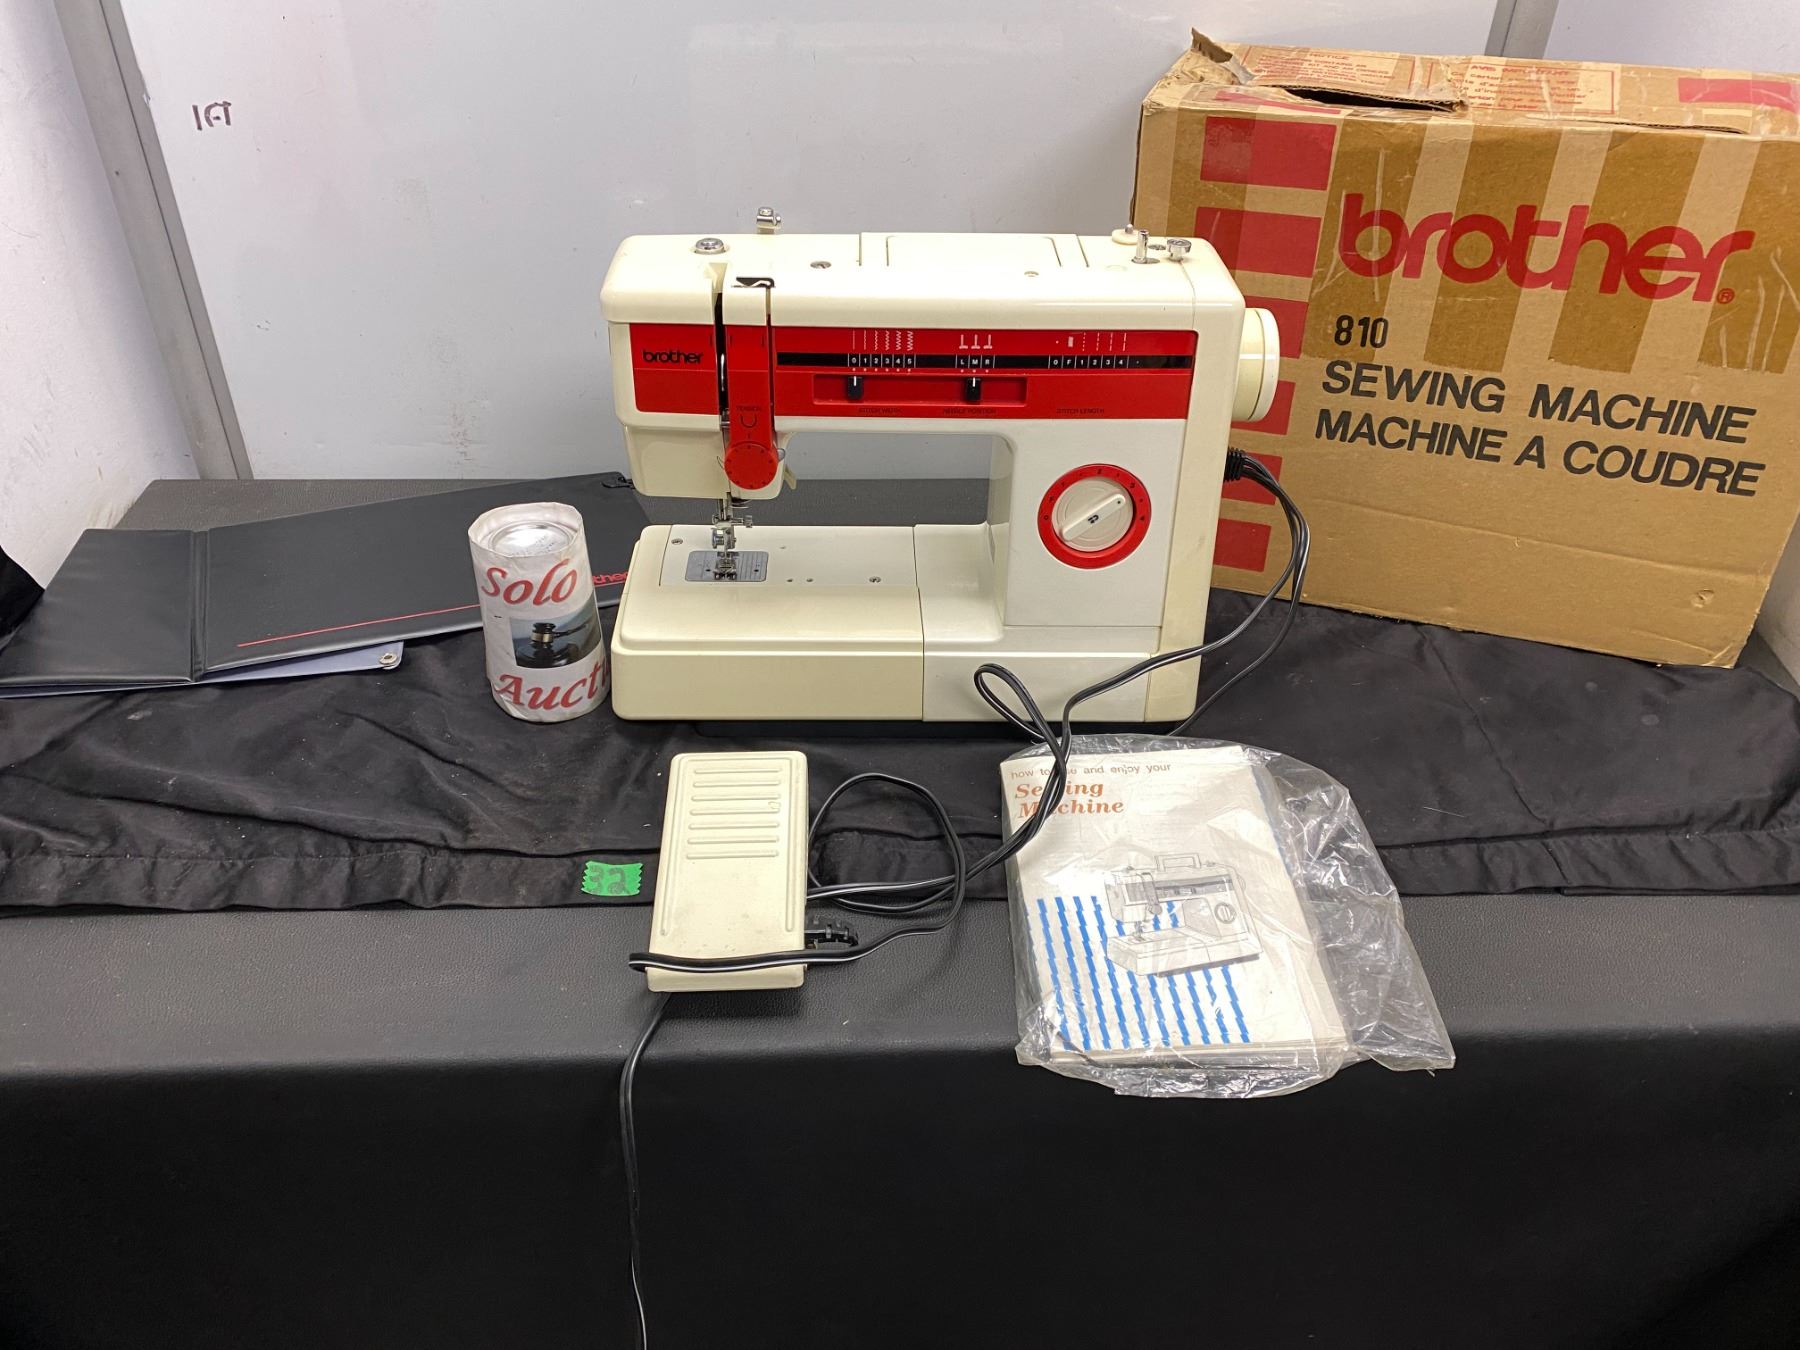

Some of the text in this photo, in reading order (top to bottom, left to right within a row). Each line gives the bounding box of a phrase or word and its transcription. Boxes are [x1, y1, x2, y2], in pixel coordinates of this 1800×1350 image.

[1338, 193, 1756, 302] brother
[1334, 315, 1389, 349] 810
[642, 350, 703, 363] brother
[1322, 360, 1757, 444] SEWING MACHINE
[1315, 409, 1766, 497] MACHINE A COUDRE
[481, 558, 577, 606] Solo
[1040, 768, 1051, 776] to
[1083, 765, 1105, 775] and
[1111, 764, 1141, 776] enjoy
[1146, 763, 1171, 774] your
[1015, 781, 1104, 798] Seing
[1018, 799, 1124, 818] Mchine
